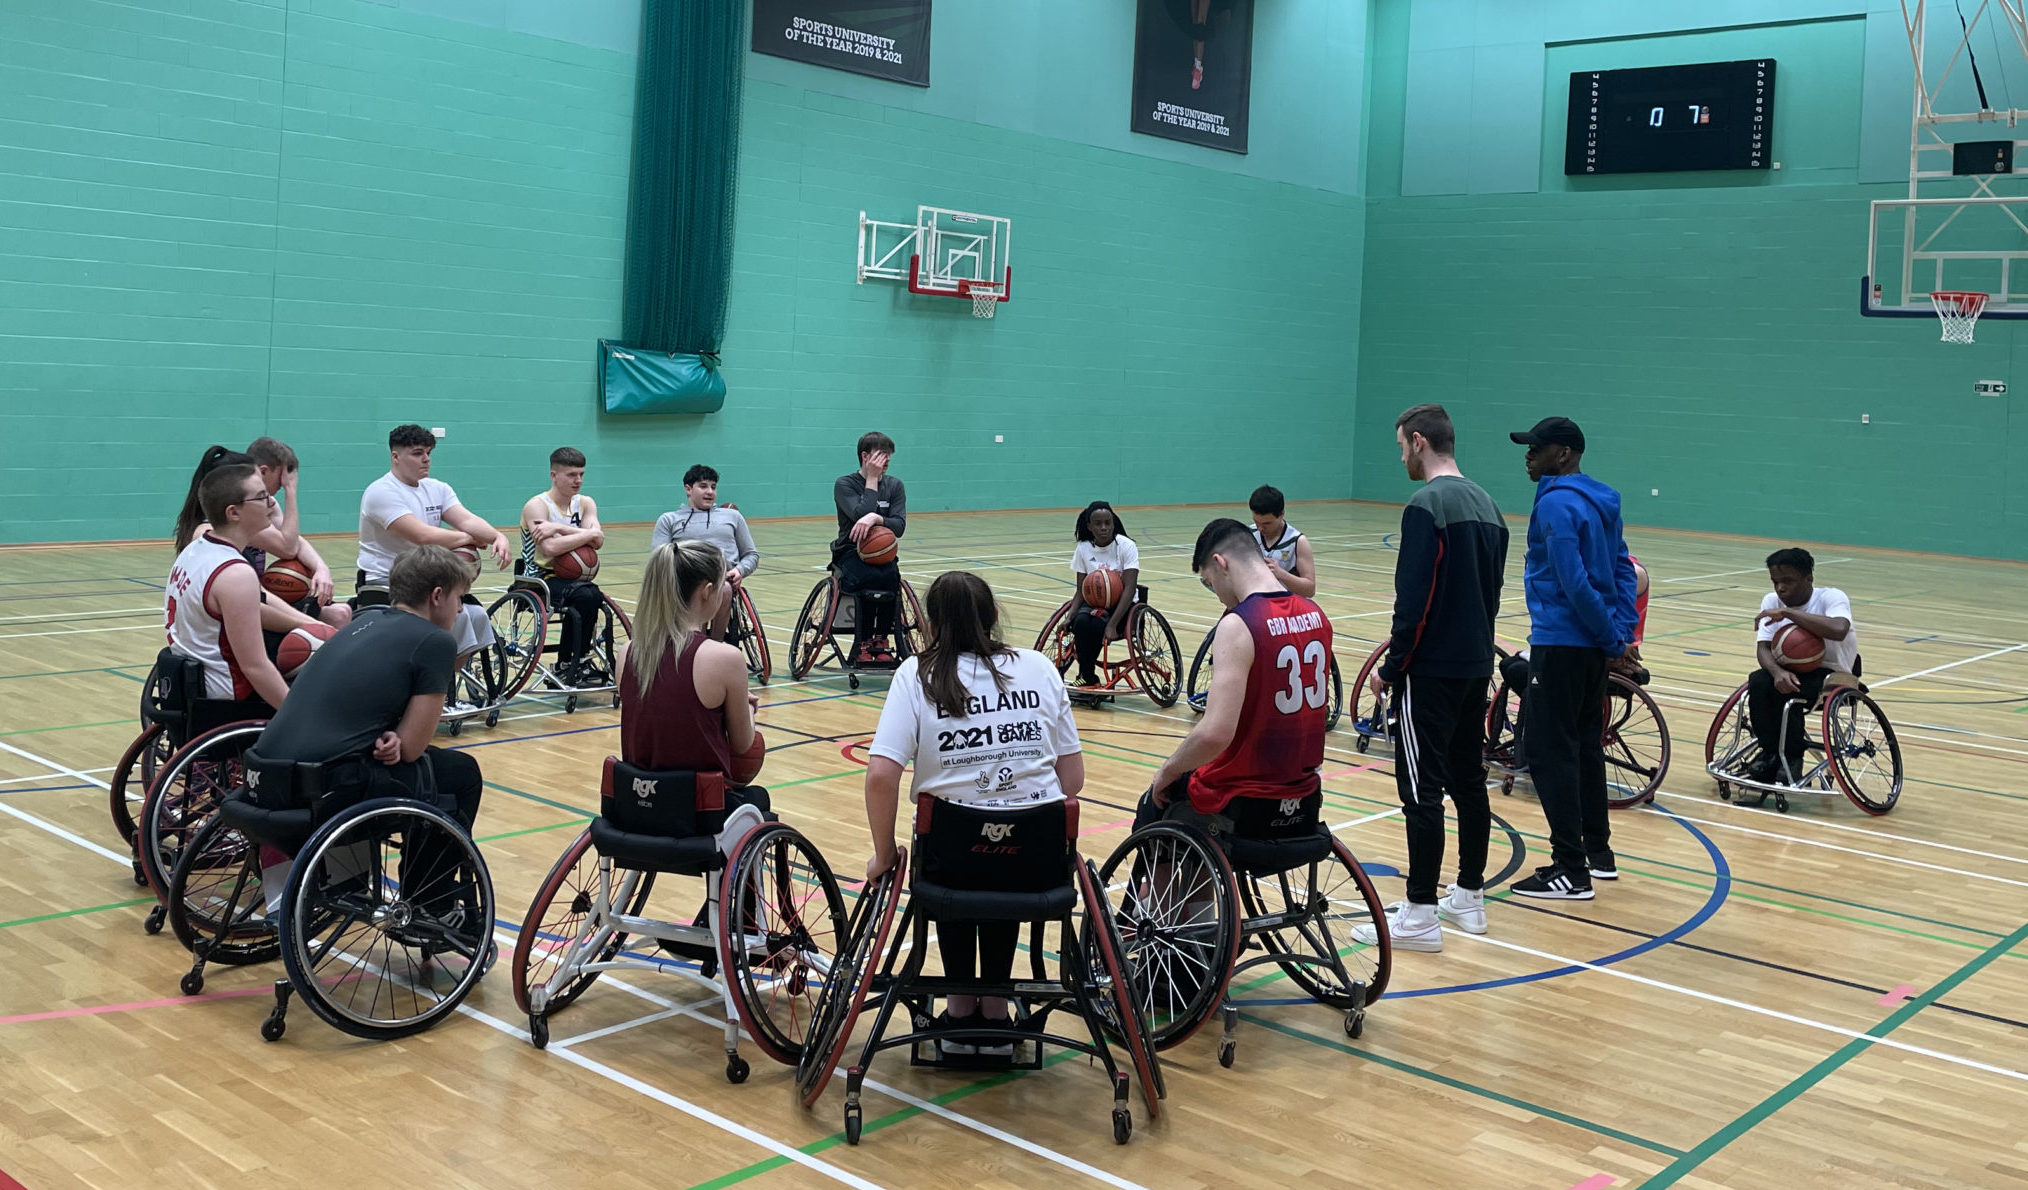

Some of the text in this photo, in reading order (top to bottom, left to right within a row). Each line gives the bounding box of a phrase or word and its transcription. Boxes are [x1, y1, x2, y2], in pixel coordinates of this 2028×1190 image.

[793, 16, 895, 50] SPORTS UNIVERSITY
[785, 28, 902, 64] OF THE YEAR 2019 & 2021
[1152, 111, 1229, 136] OF THE YEAR 2019 & 2021
[1157, 101, 1225, 125] SPORTS UNIVERSITY
[1650, 105, 1699, 126] 0 7
[571, 512, 581, 527] 4
[1266, 617, 1288, 637] GBR
[1274, 640, 1326, 715] 33
[936, 690, 1040, 720] EGLAND
[997, 720, 1042, 733] SCHOOL
[998, 730, 1042, 744] GAMES
[938, 725, 993, 752] 2021
[952, 752, 1007, 765] Loughborough
[1008, 749, 1042, 759] University
[1271, 815, 1306, 827] ELITE
[970, 845, 1022, 855] ELITE
